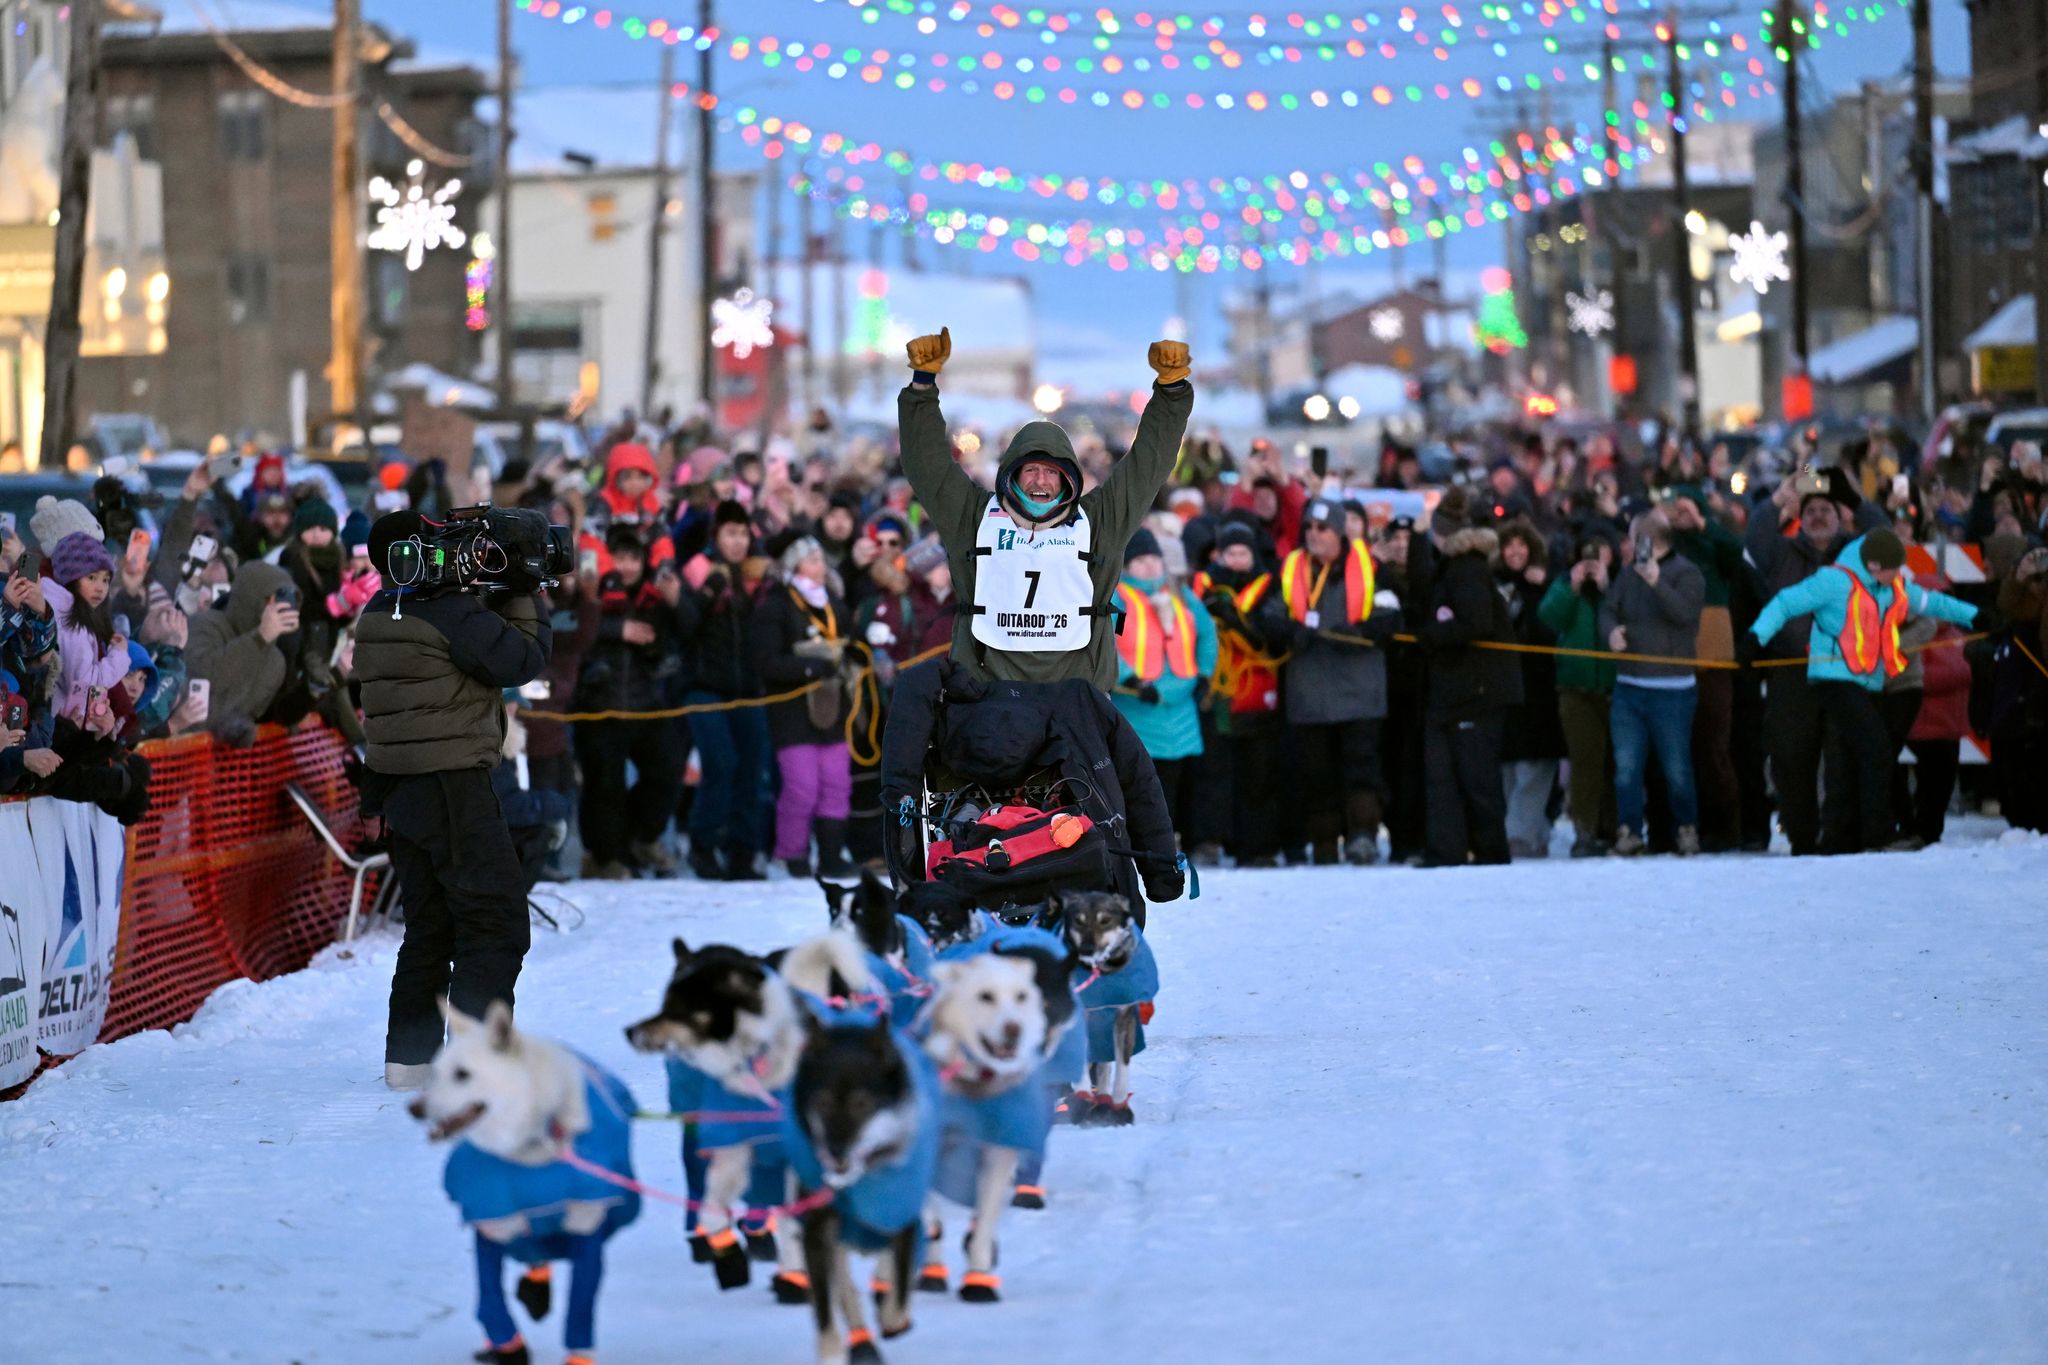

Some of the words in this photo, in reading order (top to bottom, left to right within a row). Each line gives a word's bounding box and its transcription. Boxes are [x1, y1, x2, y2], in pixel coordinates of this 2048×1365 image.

[1047, 537, 1075, 546] Alaska
[1024, 571, 1041, 609] 7
[1007, 630, 1056, 638] www.iditarod.com
